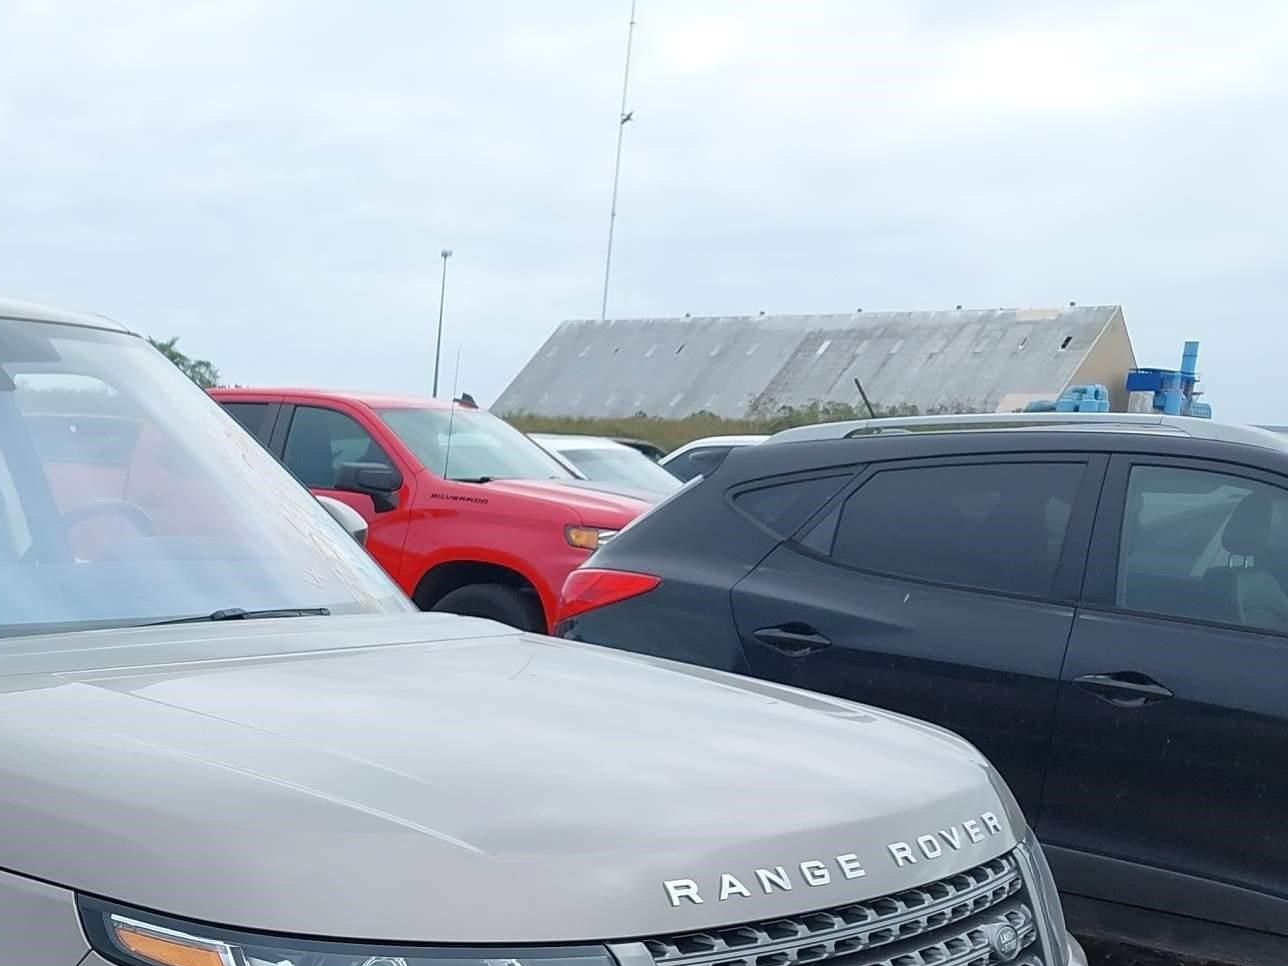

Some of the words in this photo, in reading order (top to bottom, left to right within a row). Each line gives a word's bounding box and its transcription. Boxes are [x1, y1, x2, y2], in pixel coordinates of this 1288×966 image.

[430, 493, 489, 504] SILVERADO
[661, 853, 866, 907] RANGE
[887, 811, 1003, 867] ROVER
